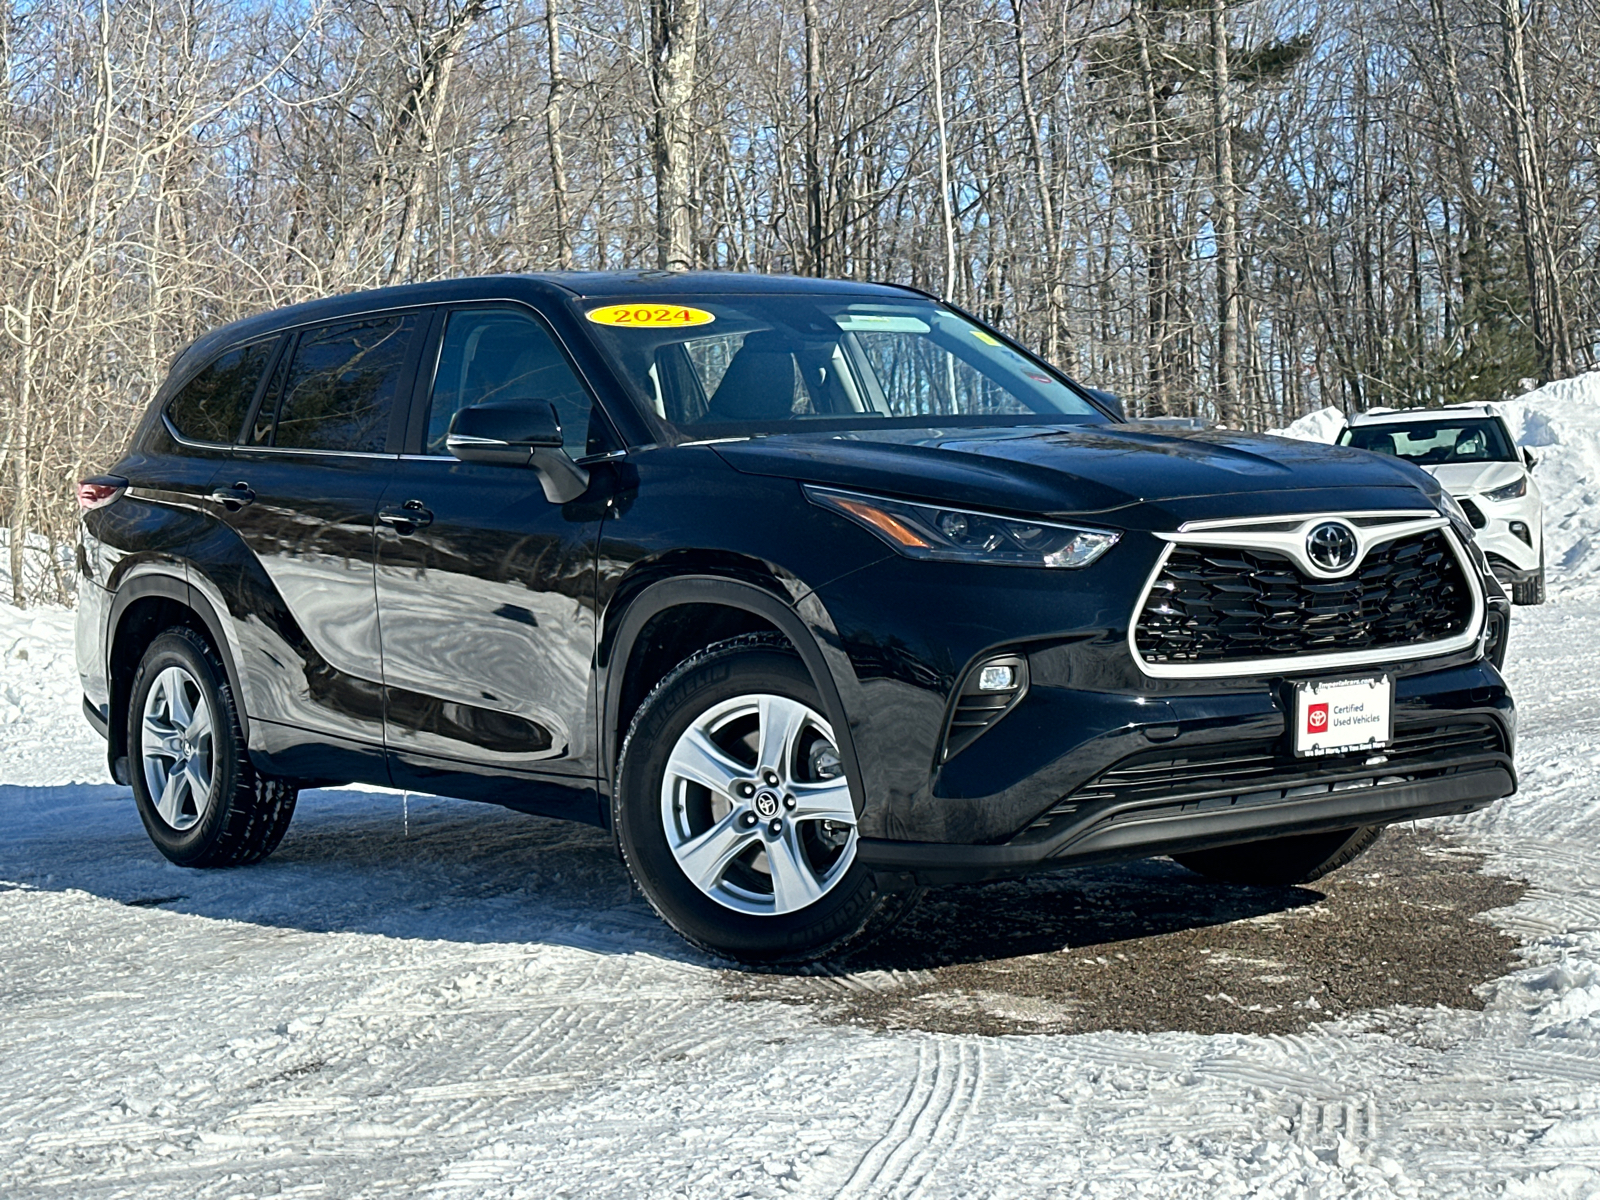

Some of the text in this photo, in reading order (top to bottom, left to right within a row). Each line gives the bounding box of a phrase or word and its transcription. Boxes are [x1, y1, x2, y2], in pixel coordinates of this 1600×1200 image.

[613, 309, 694, 323] 2024
[648, 664, 728, 735] MICHELIN
[1333, 703, 1364, 715] Certified
[1333, 714, 1380, 727] Used Vehicles
[791, 876, 876, 944] MICHELIN
